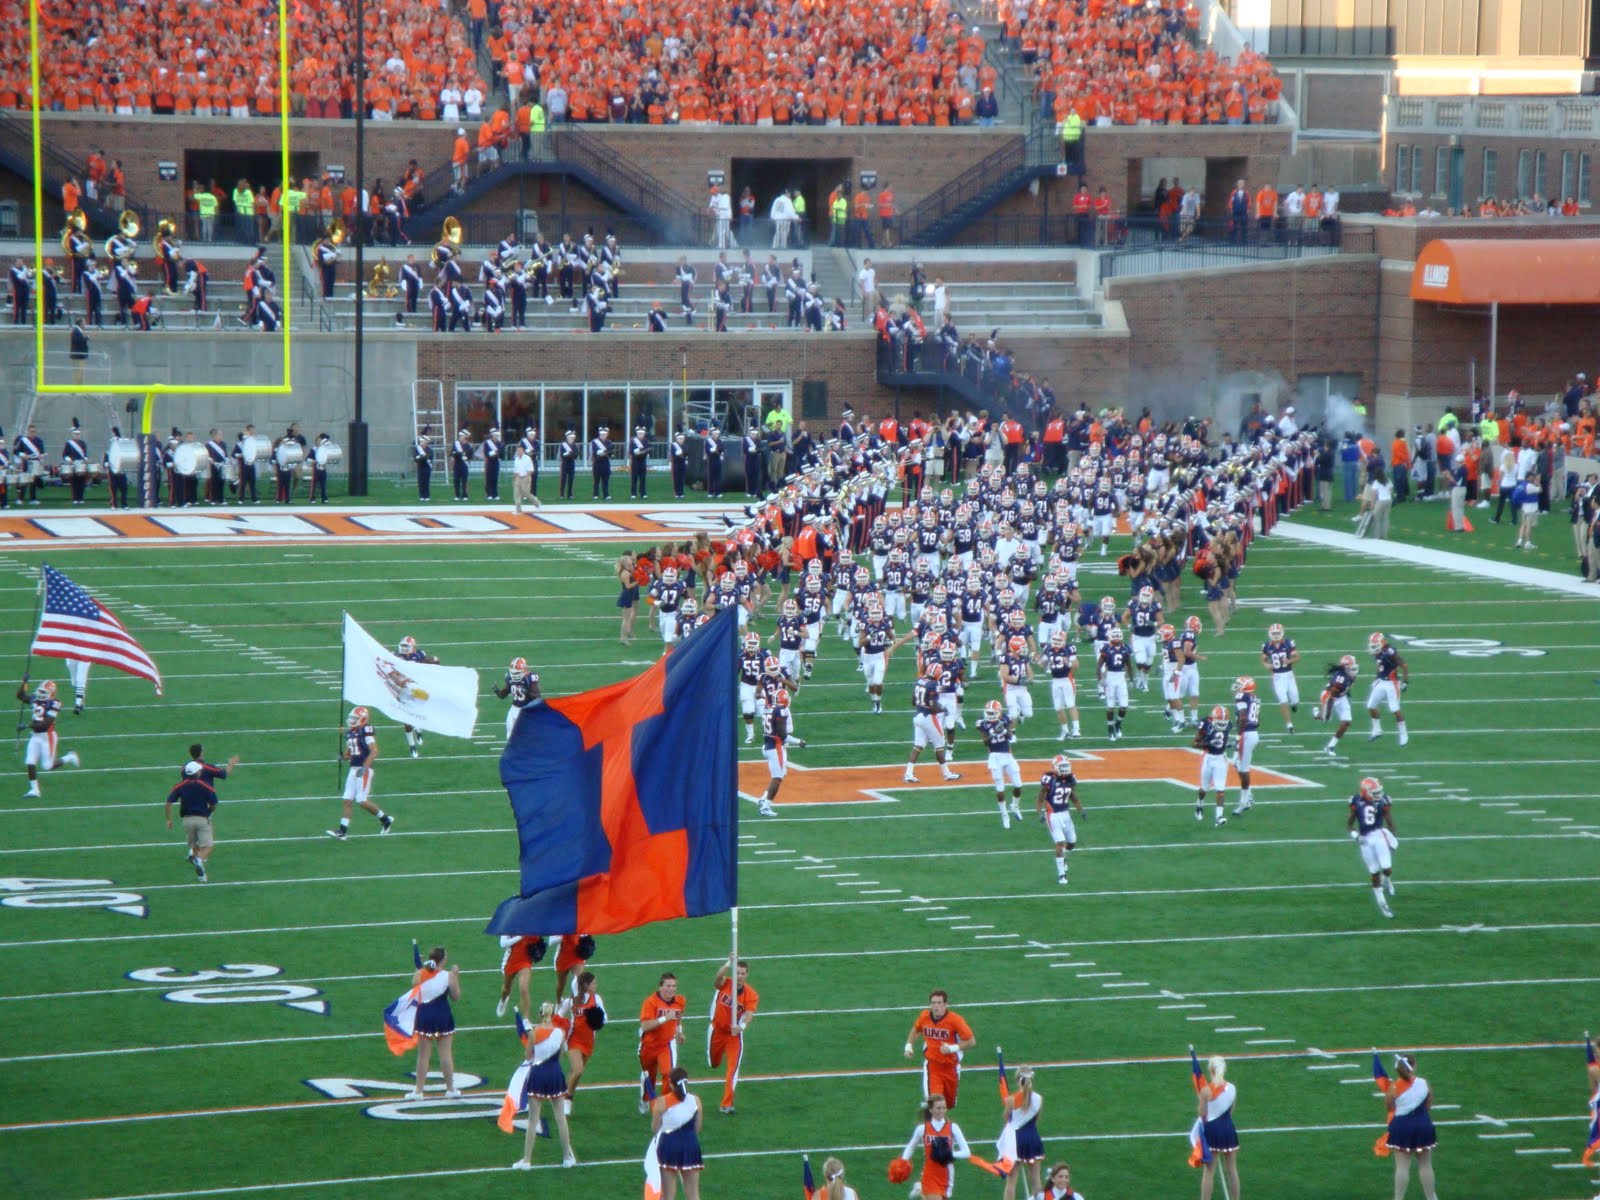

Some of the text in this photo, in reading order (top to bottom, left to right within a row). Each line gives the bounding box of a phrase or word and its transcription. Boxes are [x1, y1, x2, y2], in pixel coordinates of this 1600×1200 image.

[661, 589, 677, 604] 47
[805, 598, 820, 612] 56
[967, 599, 981, 613] 44
[743, 660, 760, 675] 55
[1053, 787, 1072, 804] 27
[1364, 805, 1376, 825] 6
[924, 1027, 949, 1039] ILLINOIS
